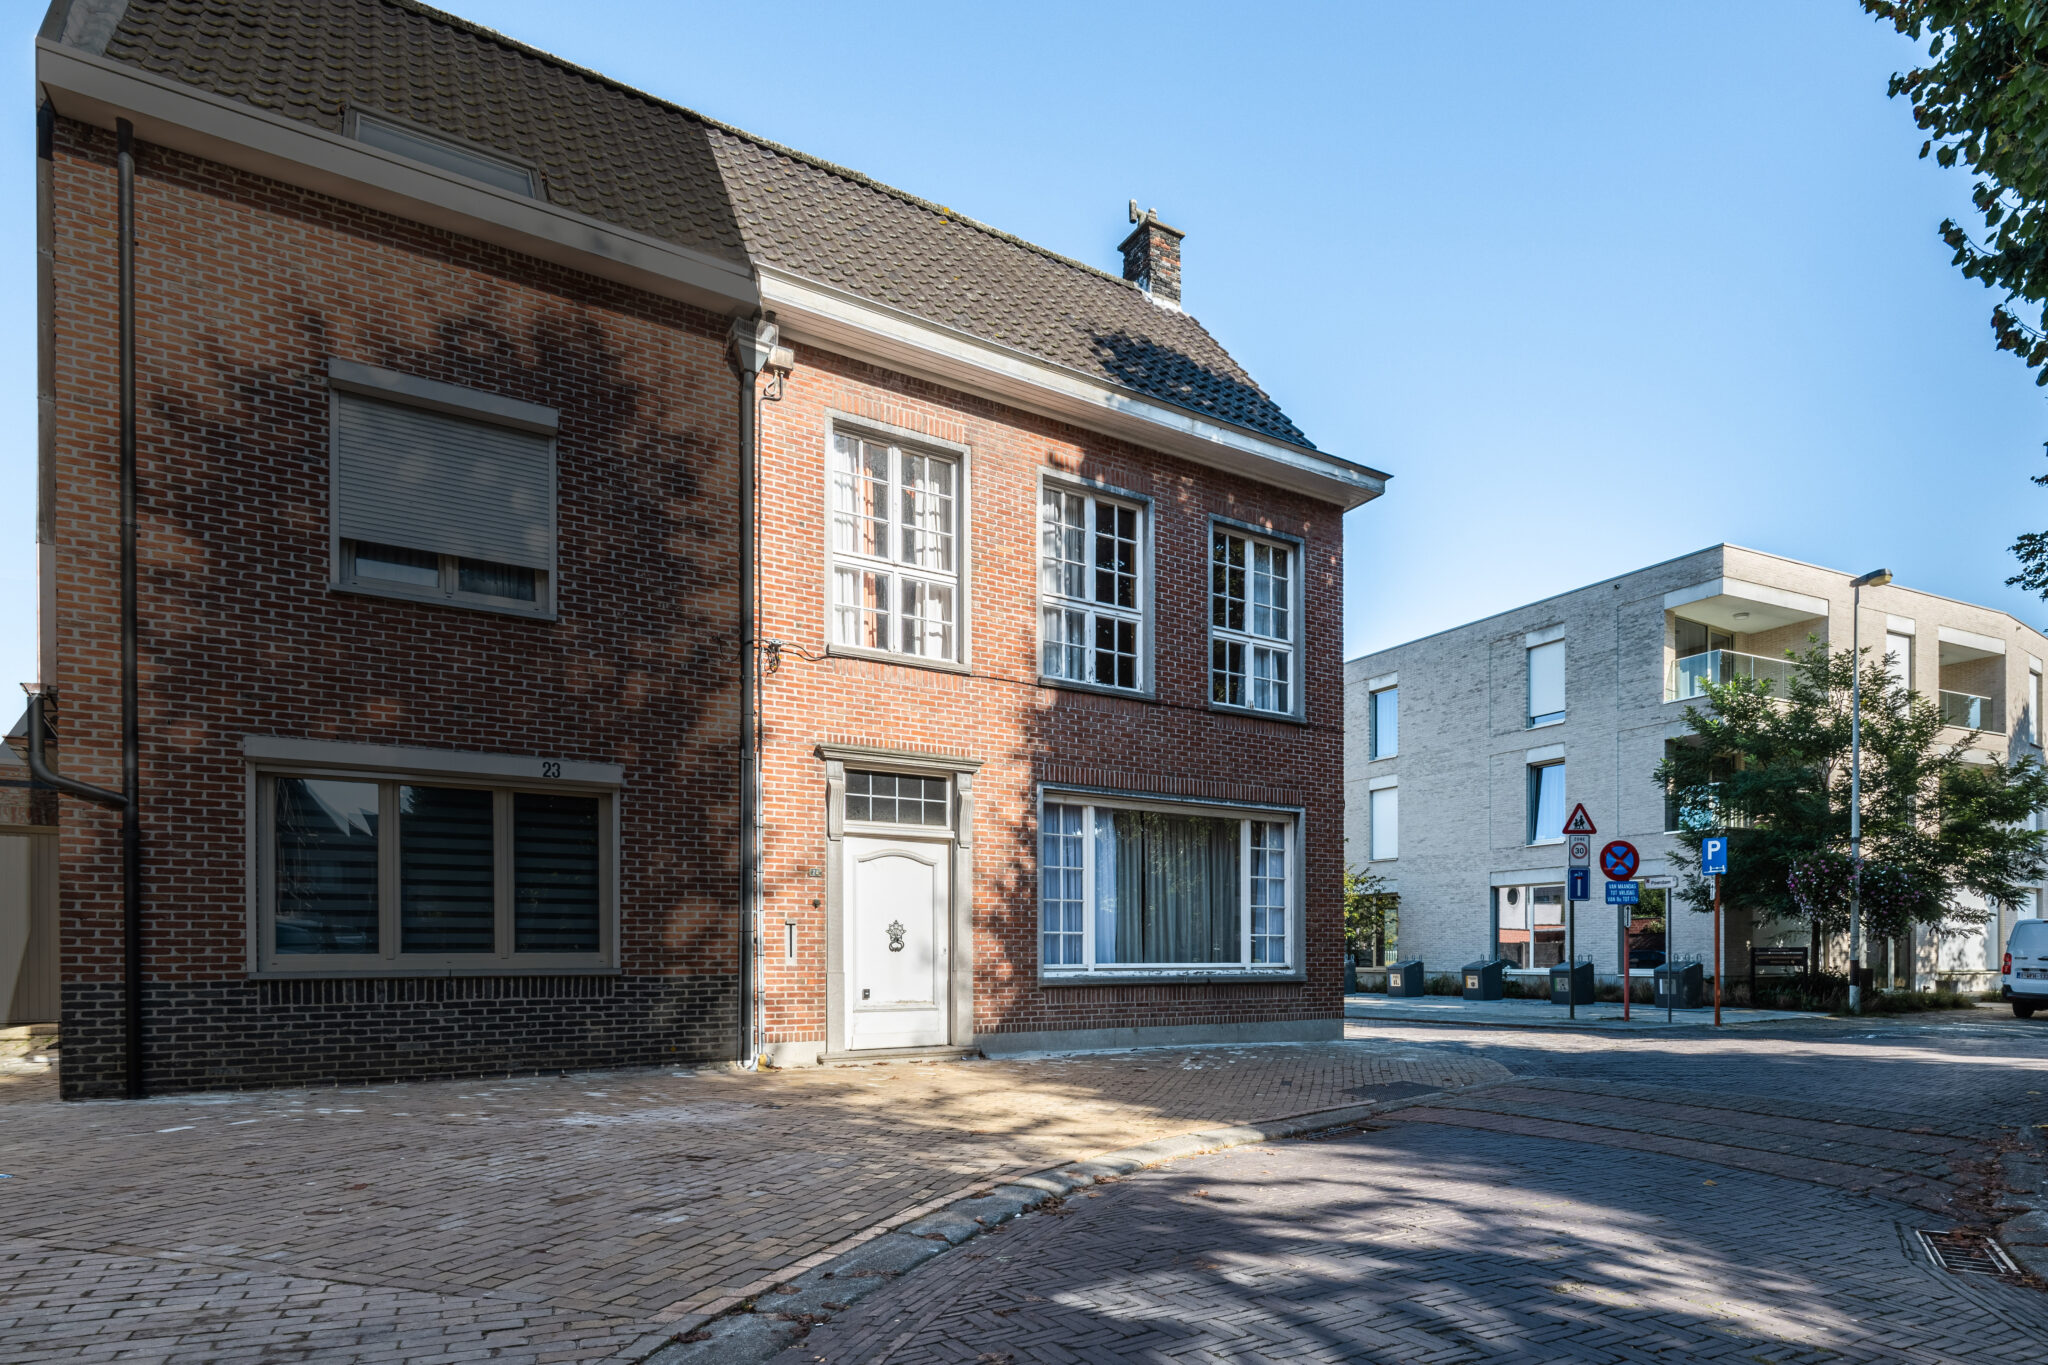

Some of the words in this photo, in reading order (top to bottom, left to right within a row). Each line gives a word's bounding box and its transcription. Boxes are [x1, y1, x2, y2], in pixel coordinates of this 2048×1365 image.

[542, 761, 560, 778] 23
[1574, 847, 1585, 855] 30
[1707, 840, 1721, 860] P
